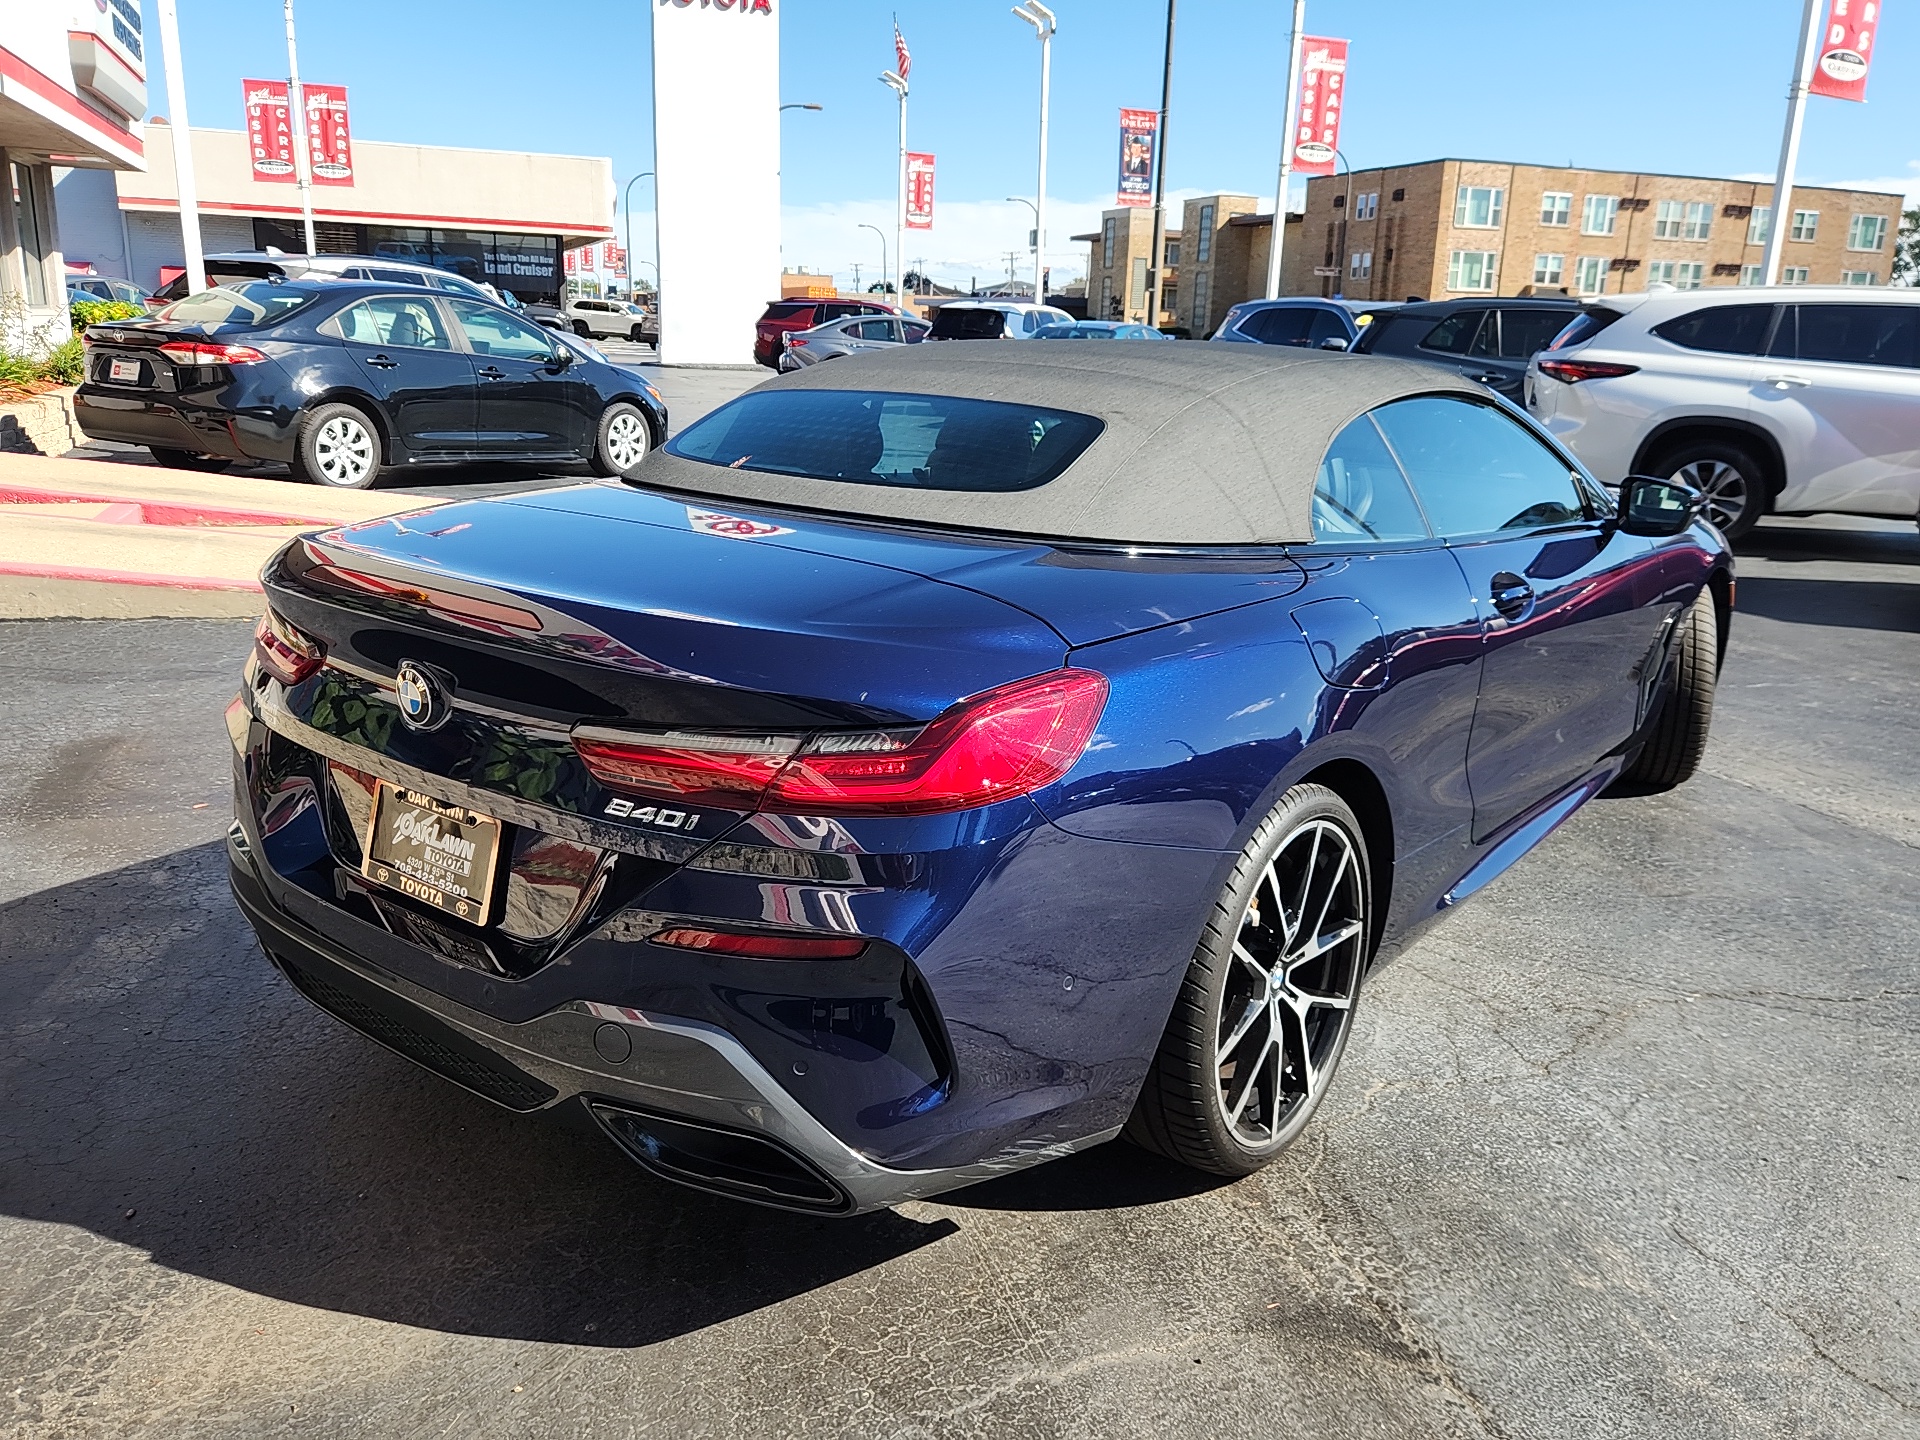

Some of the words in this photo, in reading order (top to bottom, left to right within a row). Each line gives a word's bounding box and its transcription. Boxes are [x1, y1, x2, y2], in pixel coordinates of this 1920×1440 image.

[1300, 72, 1318, 141] USED
[1323, 75, 1341, 143] CARS
[250, 106, 266, 158] USED
[275, 108, 290, 160] CARS
[309, 110, 325, 162] USED
[333, 112, 348, 164] CARS
[923, 173, 932, 213] CARS
[484, 262, 512, 275] Land
[513, 263, 554, 277] Cruiser
[500, 253, 517, 262] Drive
[517, 254, 530, 263] The
[530, 255, 540, 263] All
[540, 255, 554, 264] New
[408, 790, 431, 809] OAK
[431, 801, 464, 821] LAWN
[604, 797, 701, 831] 840i
[394, 859, 469, 898] 708-423-5200
[406, 855, 423, 869] 4320
[424, 862, 432, 873] W
[432, 866, 445, 878] 95th
[446, 870, 455, 883] St
[428, 849, 469, 875] TOYOTA
[400, 876, 443, 907] TOYOTA
